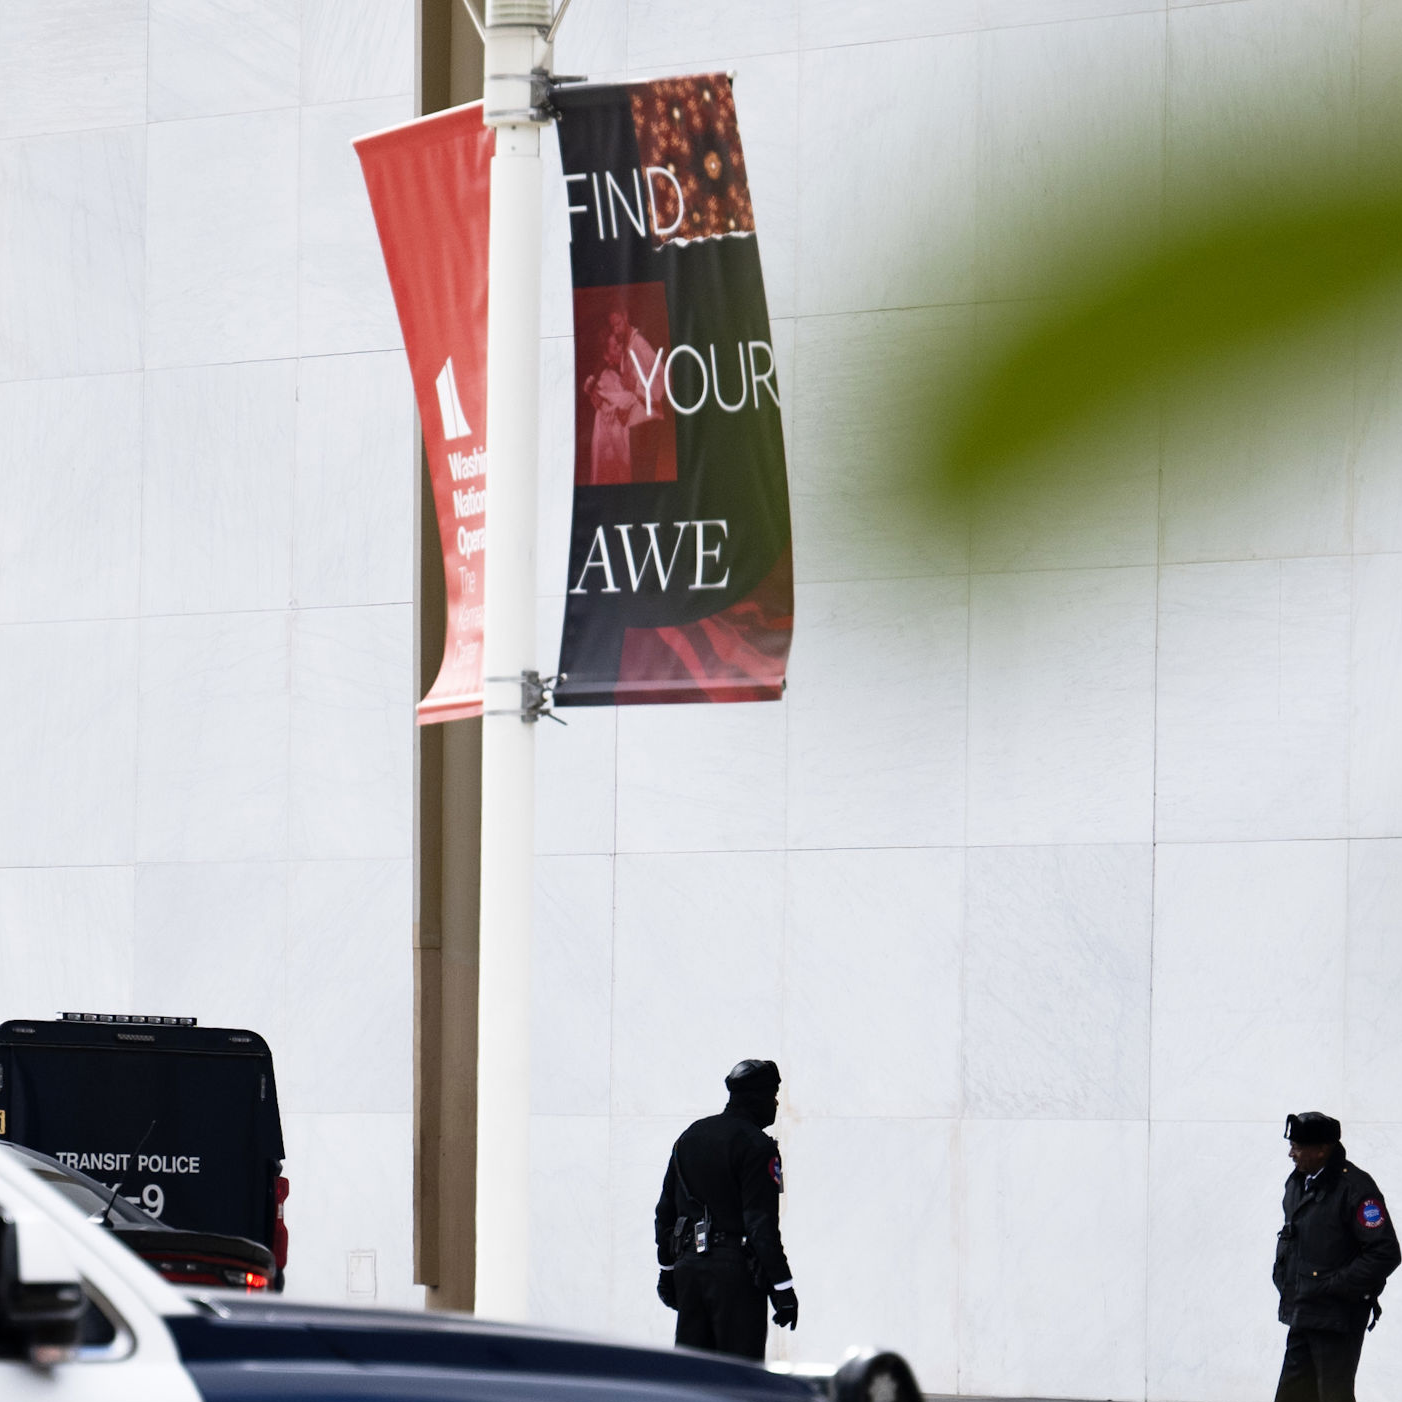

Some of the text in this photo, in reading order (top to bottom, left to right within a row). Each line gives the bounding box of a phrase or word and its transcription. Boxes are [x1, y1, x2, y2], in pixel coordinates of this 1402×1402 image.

[562, 165, 685, 242] FIND
[629, 340, 781, 417] YOUR
[569, 518, 730, 595] AWE
[56, 1152, 200, 1174] TRANSIT POLICE
